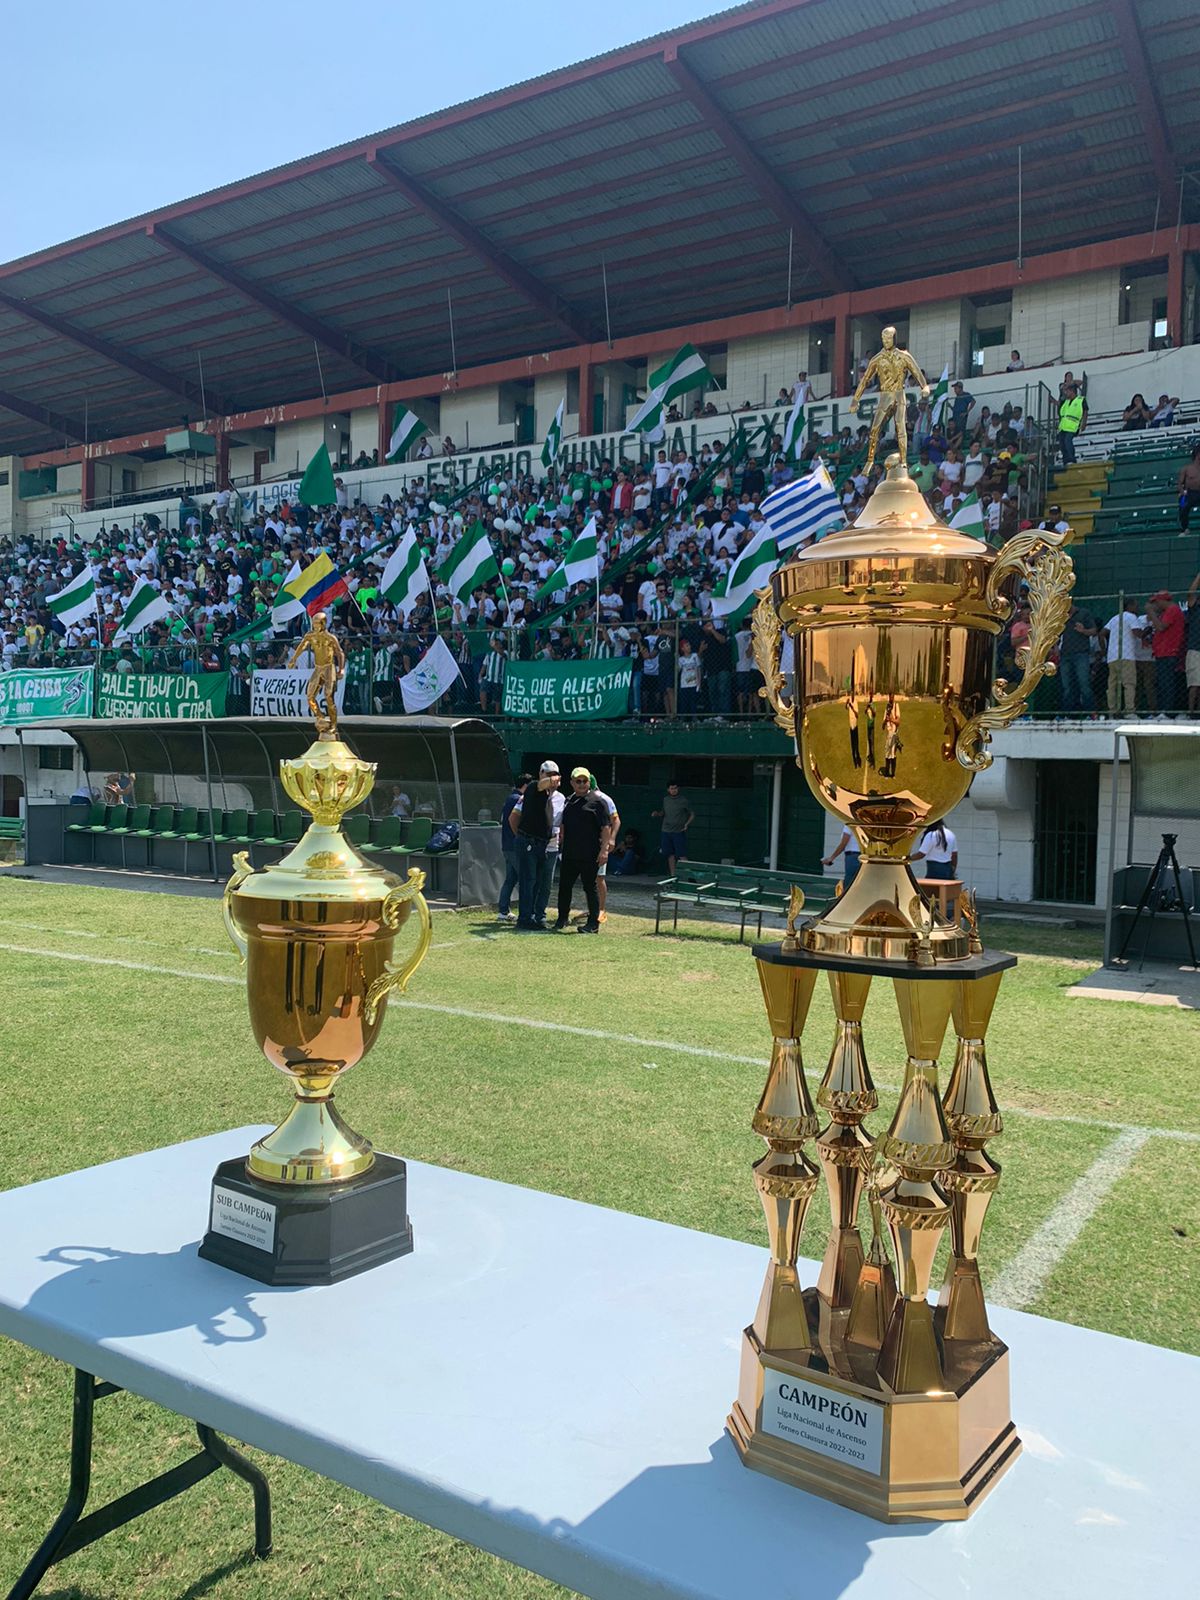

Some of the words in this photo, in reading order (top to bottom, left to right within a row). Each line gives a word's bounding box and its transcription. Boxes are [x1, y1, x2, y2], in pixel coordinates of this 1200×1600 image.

[101, 673, 135, 697] DALE
[530, 678, 557, 696] QUE
[562, 670, 632, 695] ALIENTAN
[98, 697, 156, 719] QUEREMOS
[504, 695, 538, 714] DESDE
[543, 698, 559, 714] EL
[216, 1194, 233, 1208] SUB
[233, 1200, 272, 1222] CAMPEÓN
[778, 1383, 868, 1428] CAMPEÓN
[777, 1406, 792, 1419] Liga
[793, 1411, 825, 1431] Nacional
[825, 1424, 835, 1435] de
[836, 1428, 867, 1447] Ascenso
[777, 1421, 800, 1436] Torneo
[800, 1430, 829, 1447] Clausura
[829, 1441, 865, 1460] 2022-2023
